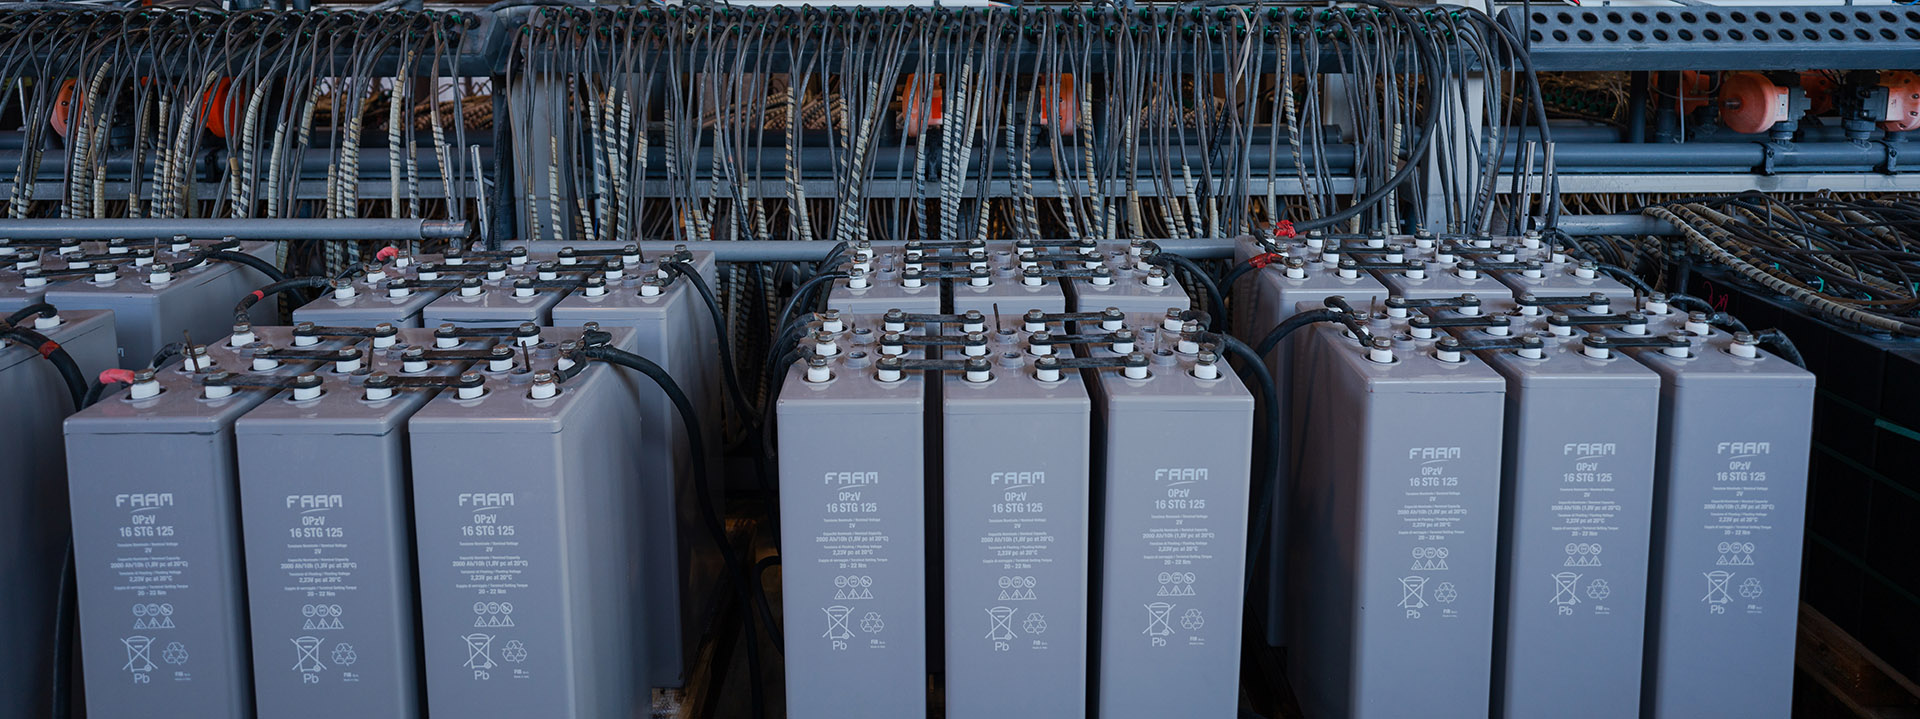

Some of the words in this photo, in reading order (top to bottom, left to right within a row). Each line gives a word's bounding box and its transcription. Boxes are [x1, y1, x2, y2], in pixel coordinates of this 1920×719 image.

[1409, 447, 1460, 459] FAAM
[1564, 442, 1615, 455] FAAM
[1717, 442, 1769, 454] FAAM
[1421, 466, 1442, 475] OPzV
[1576, 462, 1597, 471] OPzV
[1729, 461, 1751, 470] OPzV
[825, 471, 878, 484] FAAM
[991, 471, 1044, 484] FAAM
[1155, 468, 1208, 481] FAAM
[1563, 473, 1574, 482] 16
[1576, 473, 1594, 482] STG
[1596, 473, 1612, 482] 125
[1716, 472, 1728, 481] 16
[1729, 472, 1747, 481] STG
[1749, 472, 1766, 481] 125
[1409, 477, 1420, 486] 16
[1422, 477, 1439, 486] STG
[1441, 477, 1458, 486] 125
[838, 492, 860, 501] OPzV
[1004, 492, 1027, 501] OPzV
[1167, 488, 1189, 497] OPzV
[116, 493, 173, 507] FAAM
[286, 494, 342, 508] FAAM
[458, 493, 514, 506] FAAM
[1155, 499, 1166, 509] 16
[1168, 499, 1186, 509] STG
[1188, 499, 1205, 509] 125
[826, 503, 838, 512] 16
[840, 503, 858, 512] STG
[860, 502, 877, 512] 125
[992, 503, 1003, 513] 16
[1005, 503, 1024, 512] STG
[1026, 503, 1043, 512] 125
[132, 515, 156, 524] OPzV
[302, 516, 325, 526] OPzV
[474, 514, 497, 524] OPzV
[120, 527, 132, 537] 16
[134, 526, 153, 536] STG
[156, 526, 174, 536] 125
[290, 528, 302, 538] 16
[304, 527, 323, 537] STG
[325, 527, 343, 537] 125
[462, 526, 474, 536] 16
[475, 525, 494, 535] STG
[497, 525, 514, 535] 125
[1406, 609, 1421, 619] Pb
[1558, 606, 1573, 615] Pb
[1710, 604, 1725, 614] Pb
[832, 640, 847, 650] Pb
[995, 641, 1010, 651] Pb
[1152, 637, 1167, 647] Pb
[134, 673, 150, 683] Pb
[303, 673, 319, 683] Pb
[474, 670, 490, 680] Pb
